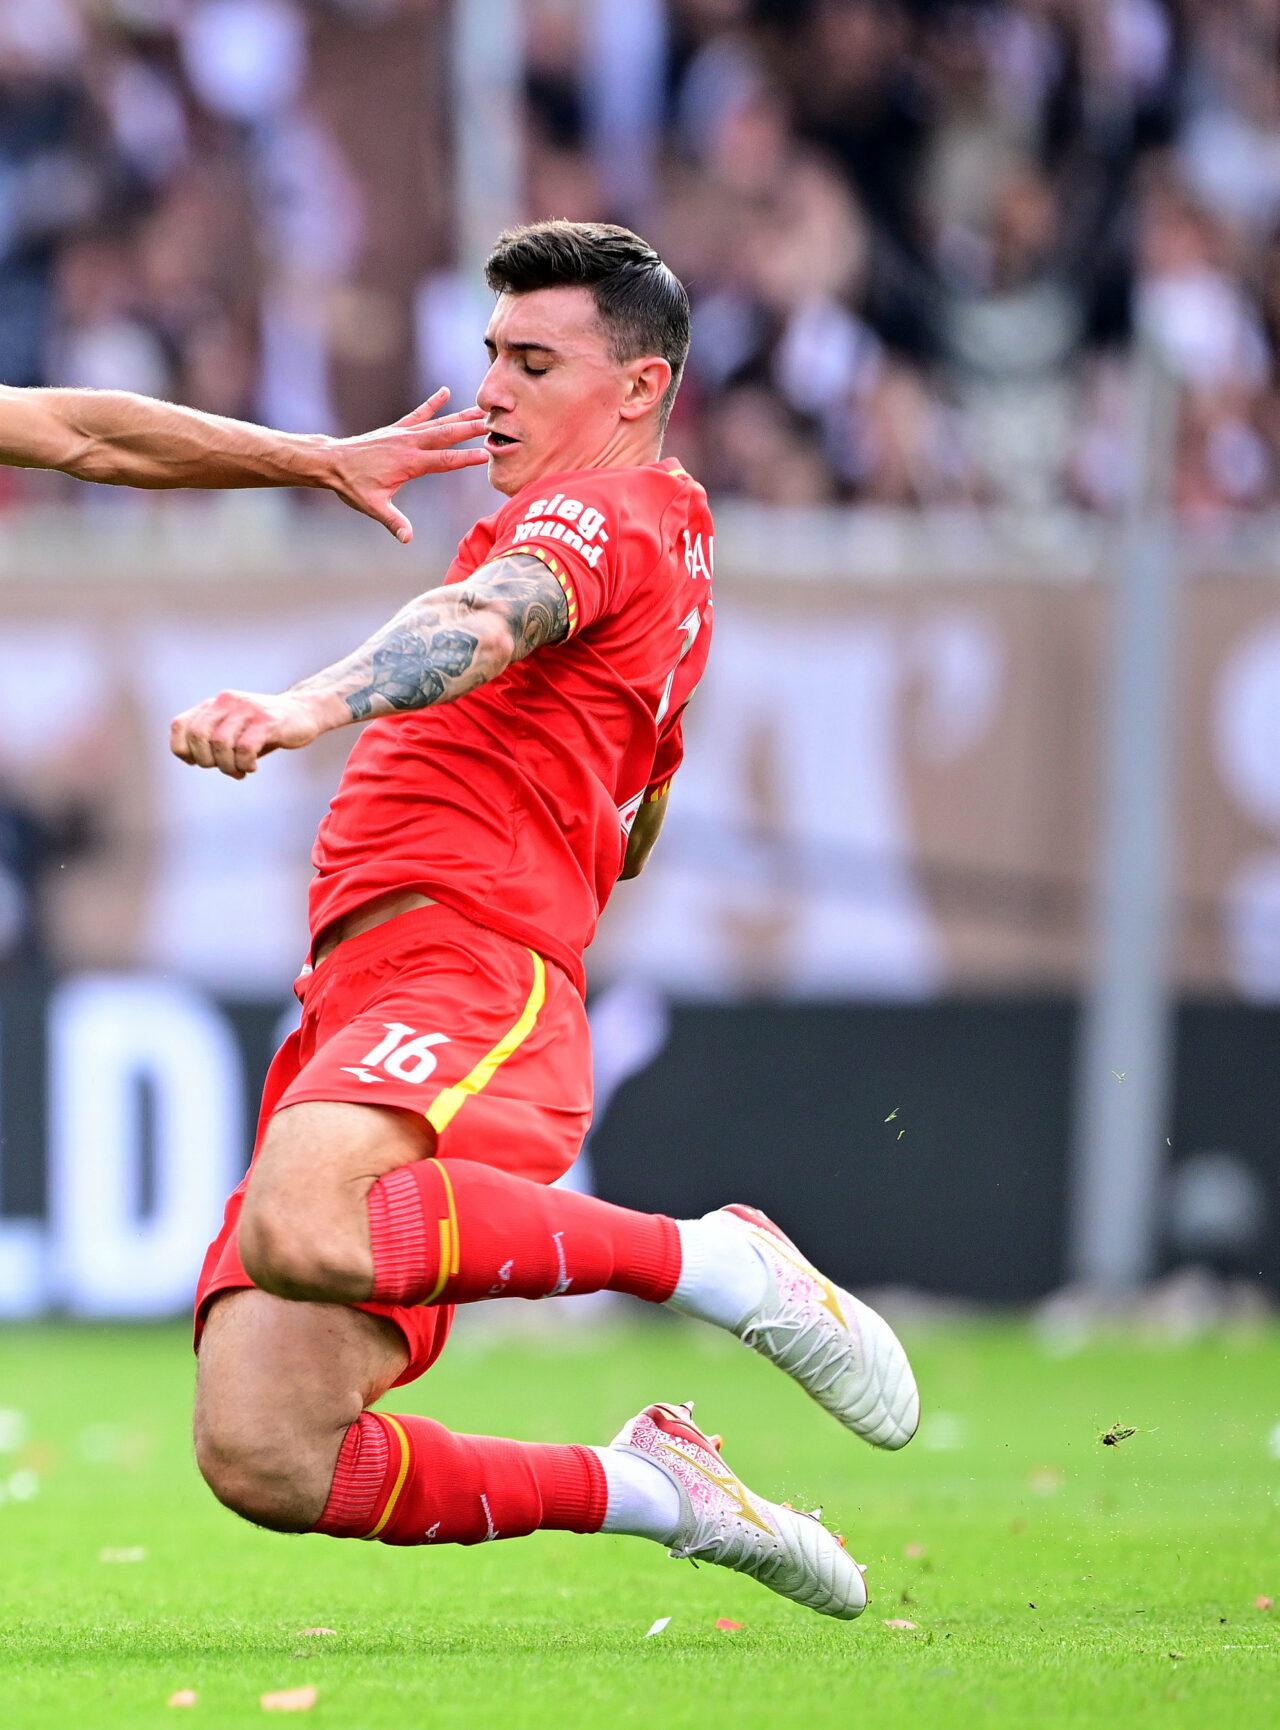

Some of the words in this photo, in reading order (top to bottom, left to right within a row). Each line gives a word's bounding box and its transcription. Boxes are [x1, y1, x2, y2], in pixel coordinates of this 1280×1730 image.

[524, 494, 609, 542] sieg-
[512, 521, 604, 568] mund
[360, 1022, 452, 1084] 16
